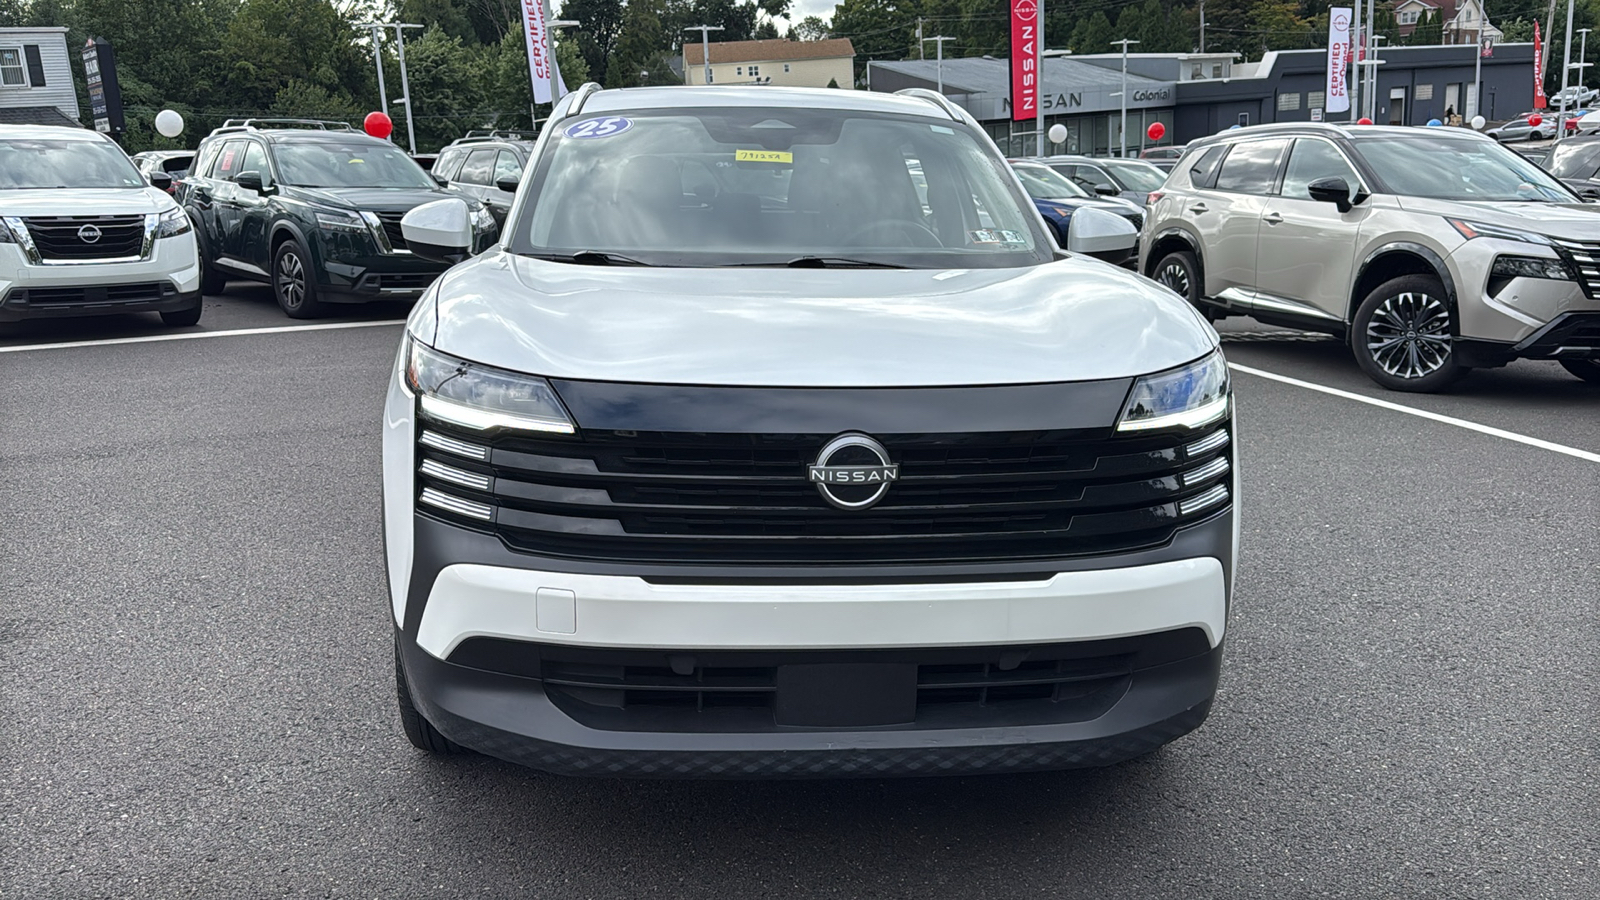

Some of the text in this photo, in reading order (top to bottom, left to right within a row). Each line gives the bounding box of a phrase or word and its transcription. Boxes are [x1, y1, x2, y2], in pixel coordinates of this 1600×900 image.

[1022, 26, 1034, 110] NISSAN
[1331, 42, 1341, 96] CERTIFIED
[1003, 93, 1082, 112] NSAN
[1133, 88, 1170, 102] Colonial
[572, 118, 621, 138] 25
[811, 469, 897, 482] NISSAN
